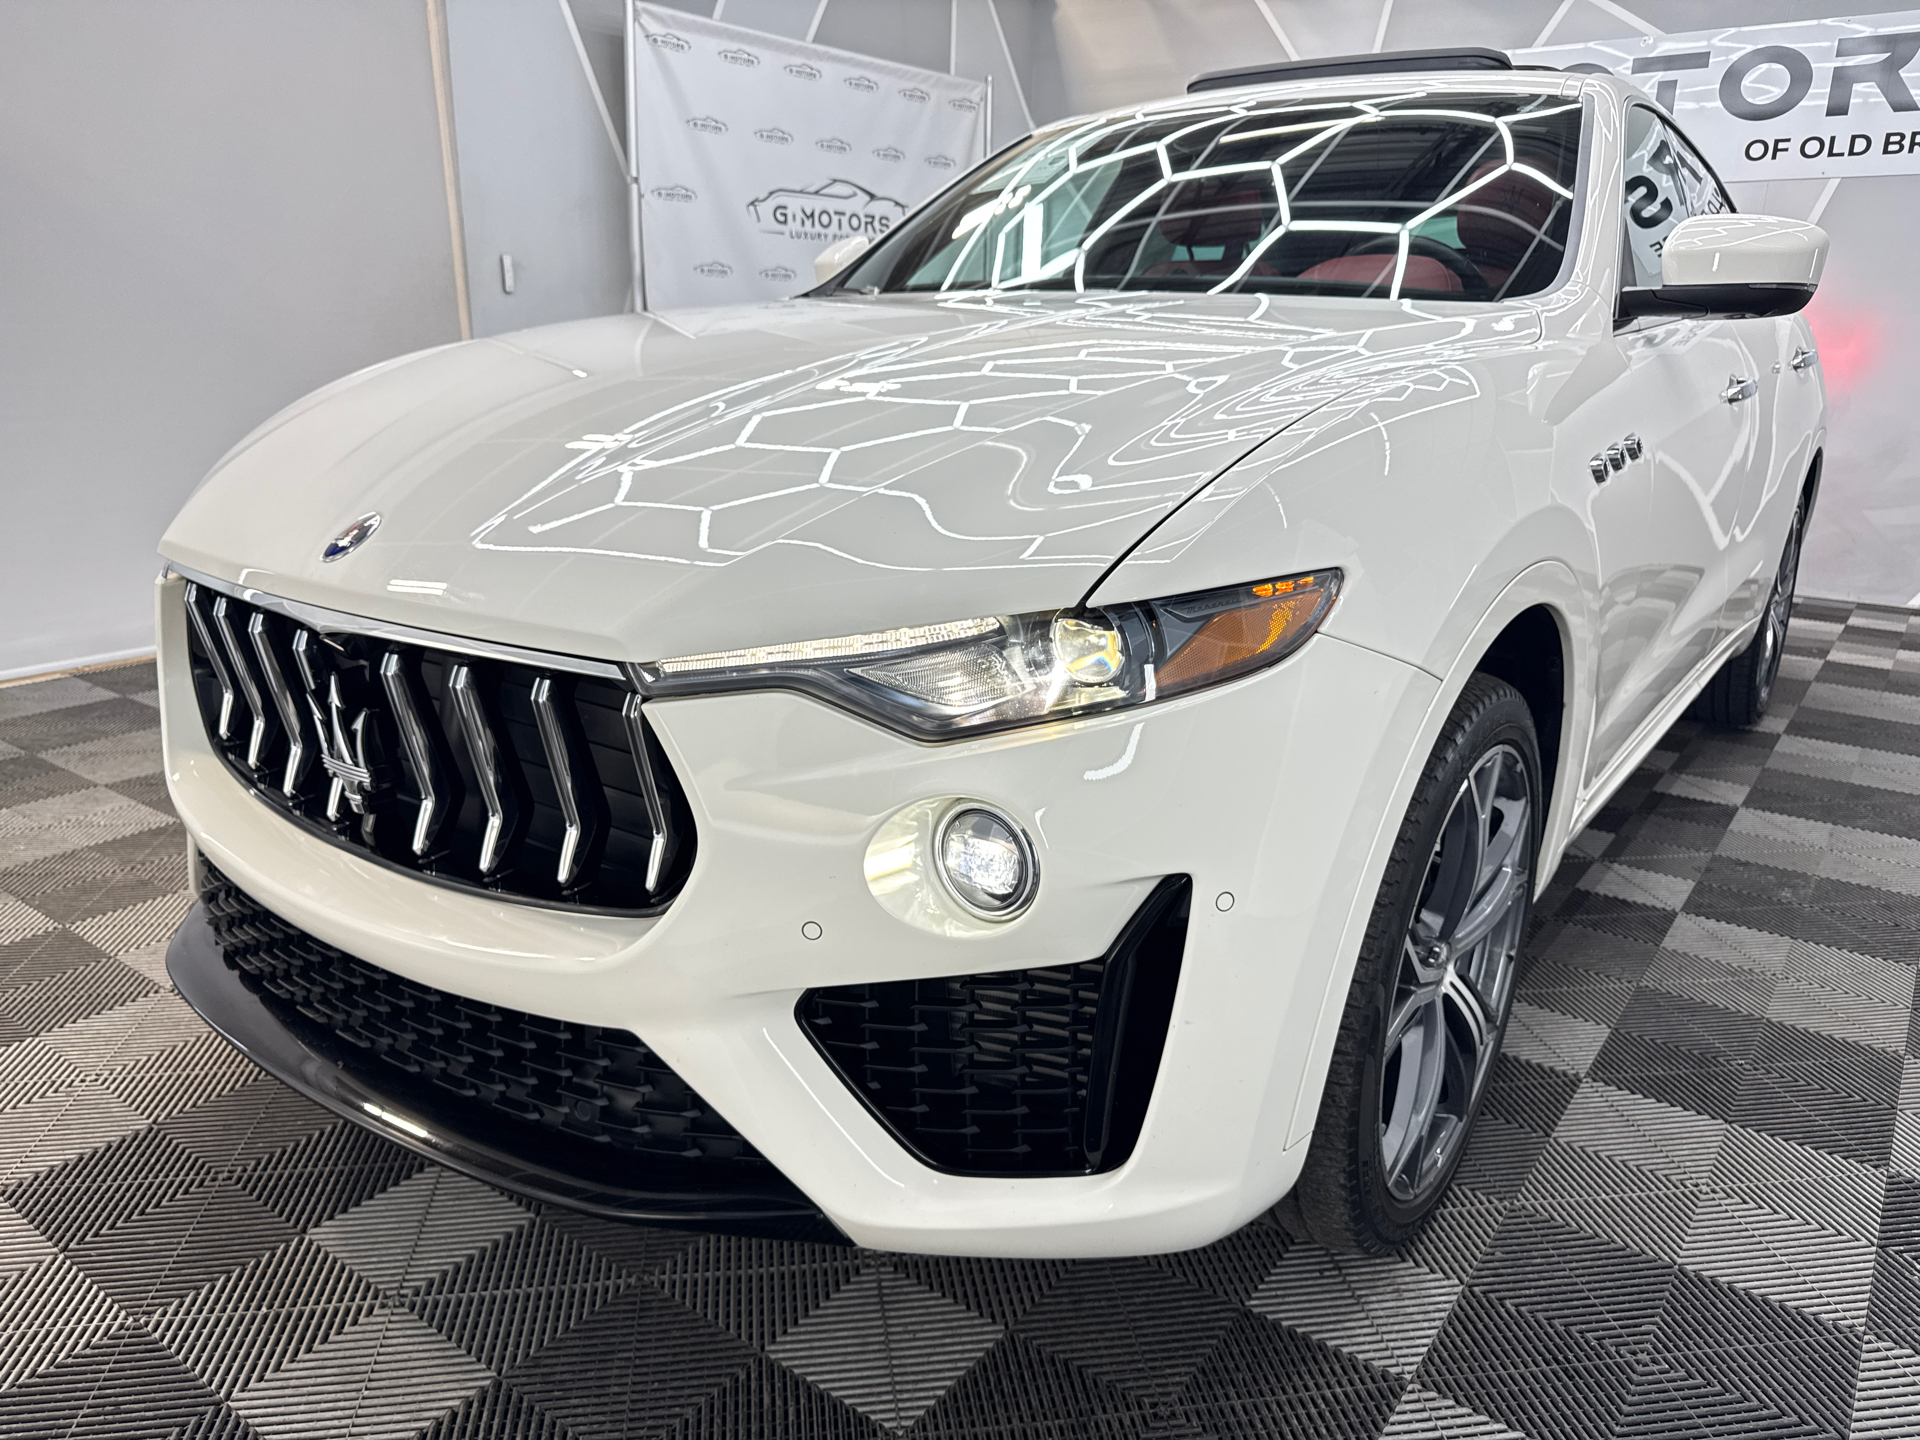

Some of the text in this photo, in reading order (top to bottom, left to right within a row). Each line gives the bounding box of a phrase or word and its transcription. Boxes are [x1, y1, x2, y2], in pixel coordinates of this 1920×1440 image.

[1745, 138, 1791, 161] OF
[1799, 134, 1872, 159] OLD
[789, 229, 829, 242] LUXURY
